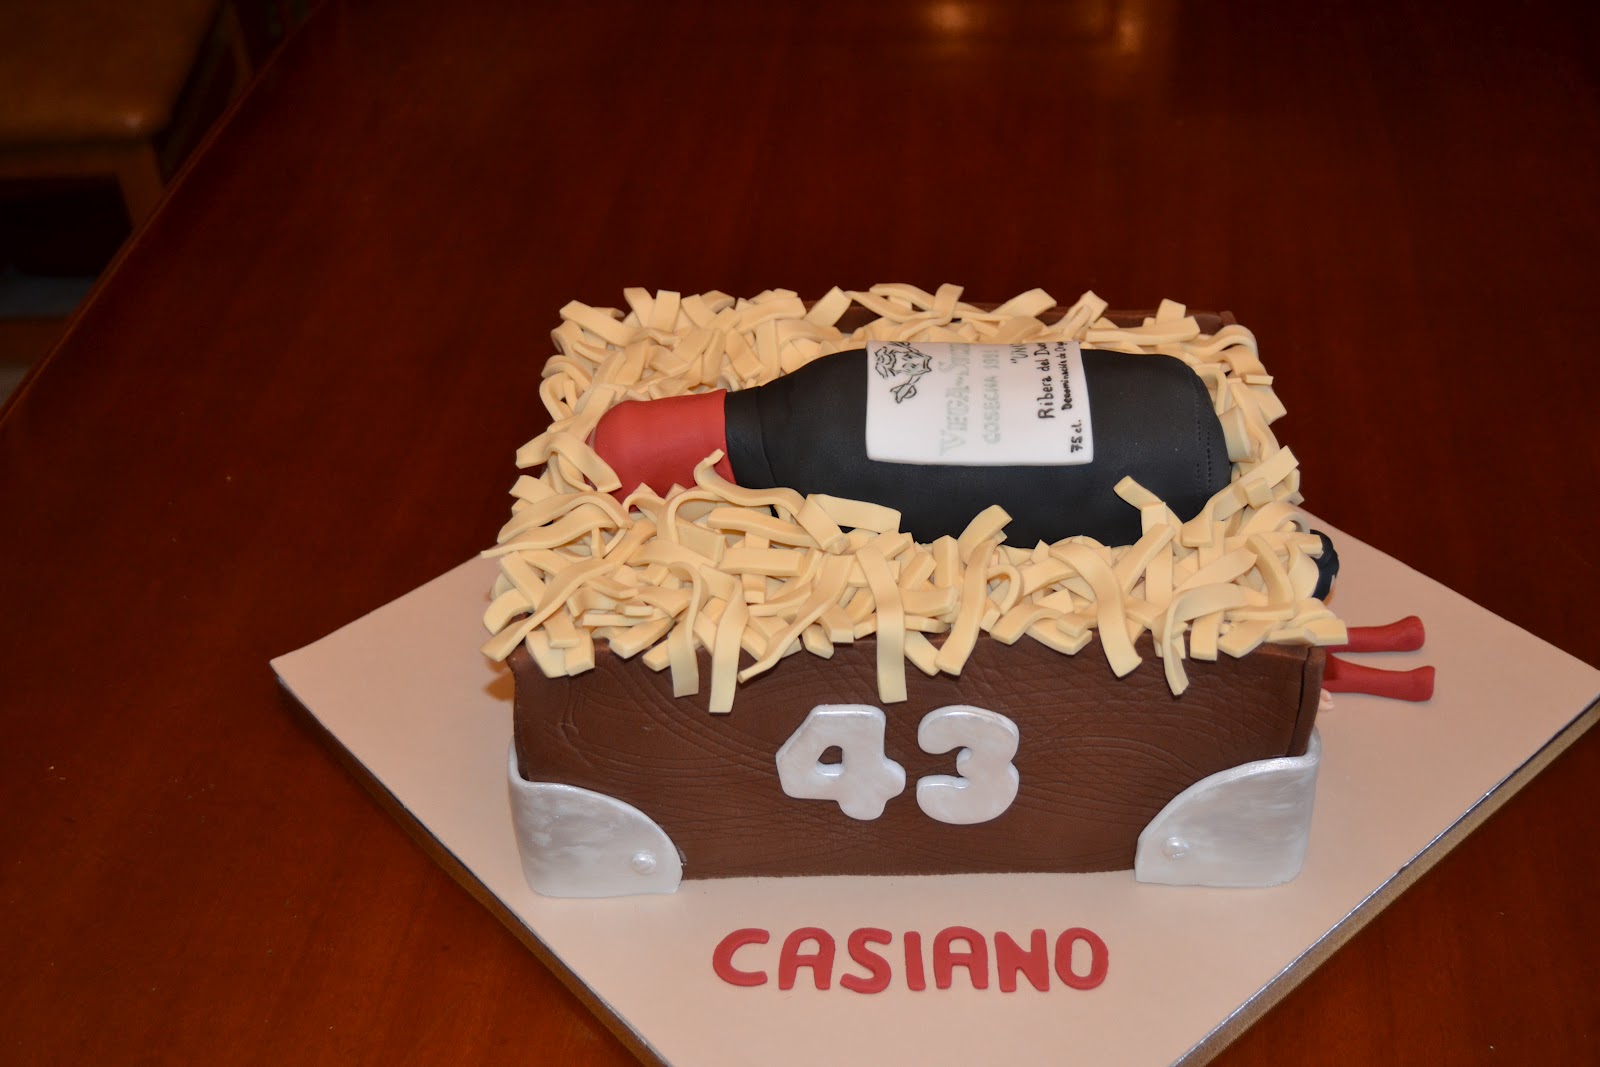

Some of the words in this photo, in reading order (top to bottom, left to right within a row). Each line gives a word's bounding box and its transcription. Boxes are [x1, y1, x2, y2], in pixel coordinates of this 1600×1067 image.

[1034, 358, 1050, 372] del
[983, 376, 1001, 445] COSECHA
[1037, 375, 1055, 419] Ribera
[1070, 436, 1083, 453] 75
[776, 704, 1020, 825] 43
[712, 926, 1109, 994] CASIANO
